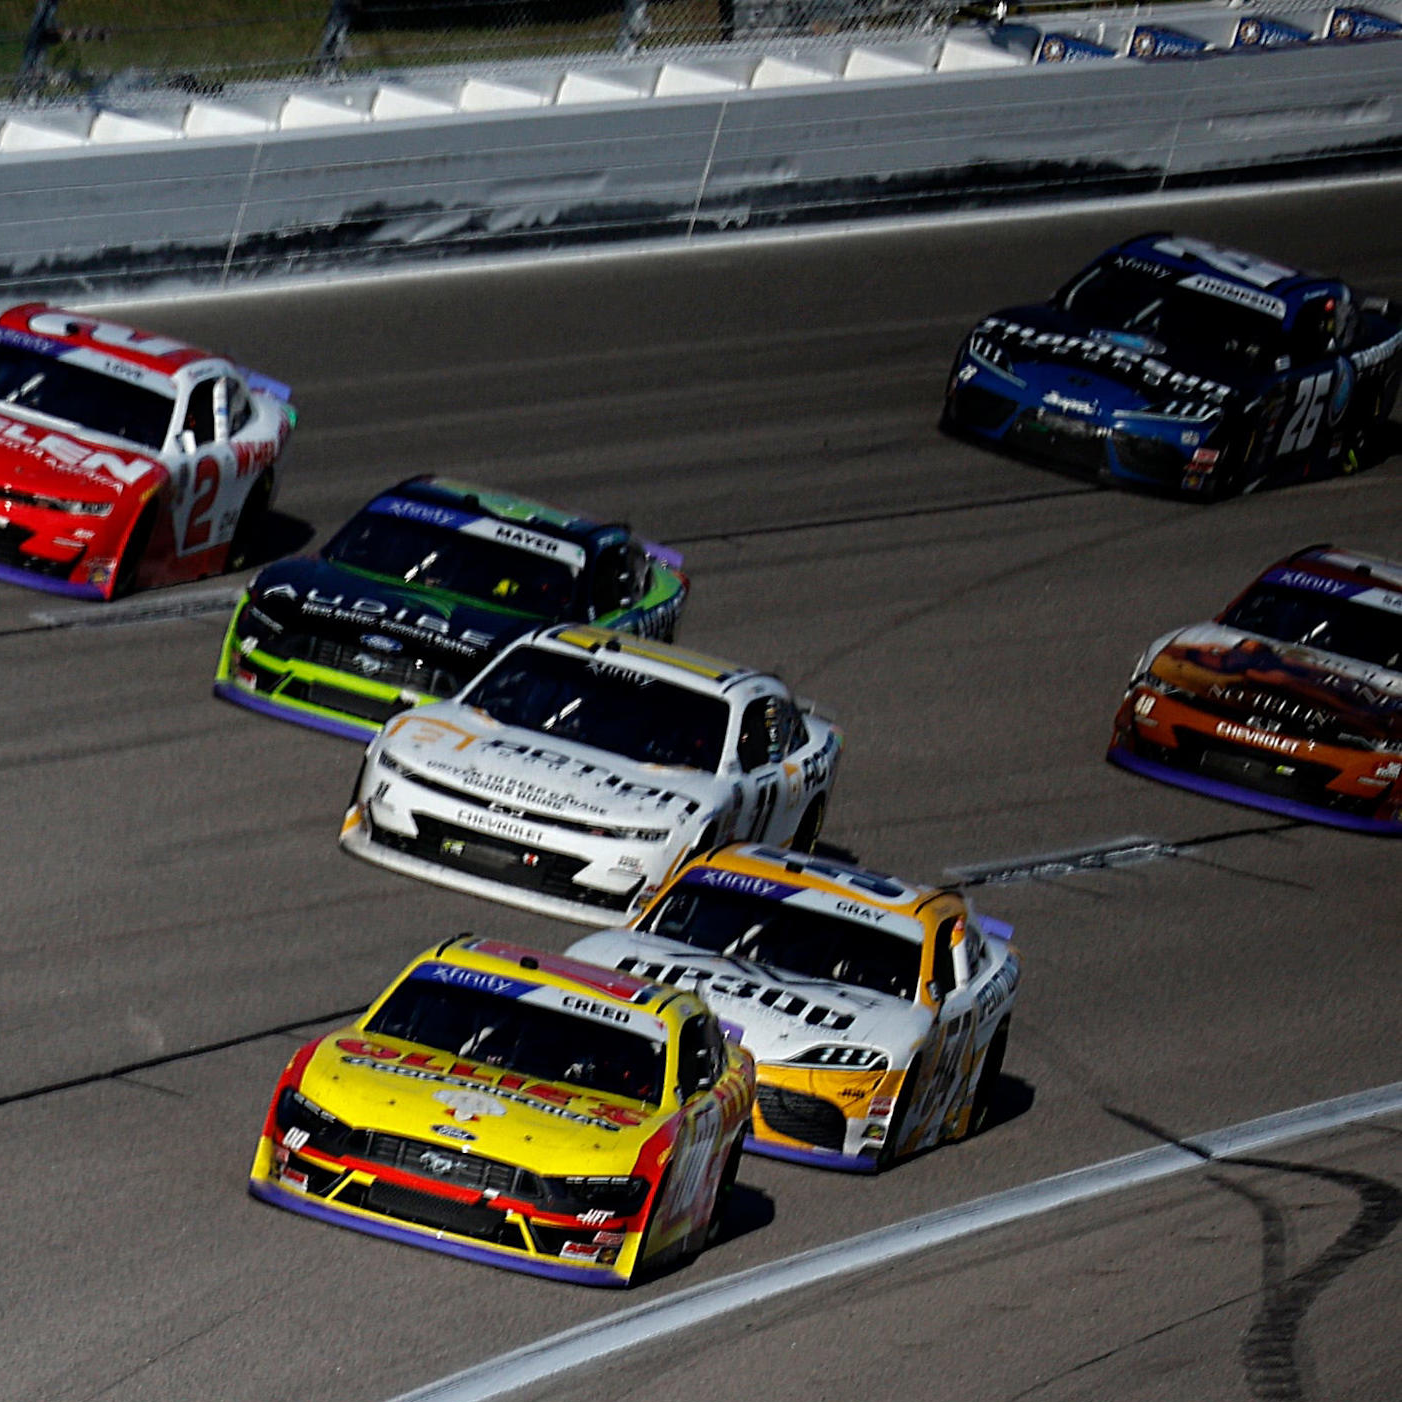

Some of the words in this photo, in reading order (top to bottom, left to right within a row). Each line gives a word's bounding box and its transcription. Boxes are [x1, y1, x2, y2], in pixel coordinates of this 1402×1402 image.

[1277, 370, 1333, 456] 26
[183, 455, 219, 552] 2
[496, 525, 559, 553] MAYER
[456, 809, 544, 844] CHEVROLET
[701, 869, 778, 896] xfinity
[835, 900, 889, 923] GRAY
[432, 965, 512, 994] xfinity
[562, 994, 631, 1024] CREED
